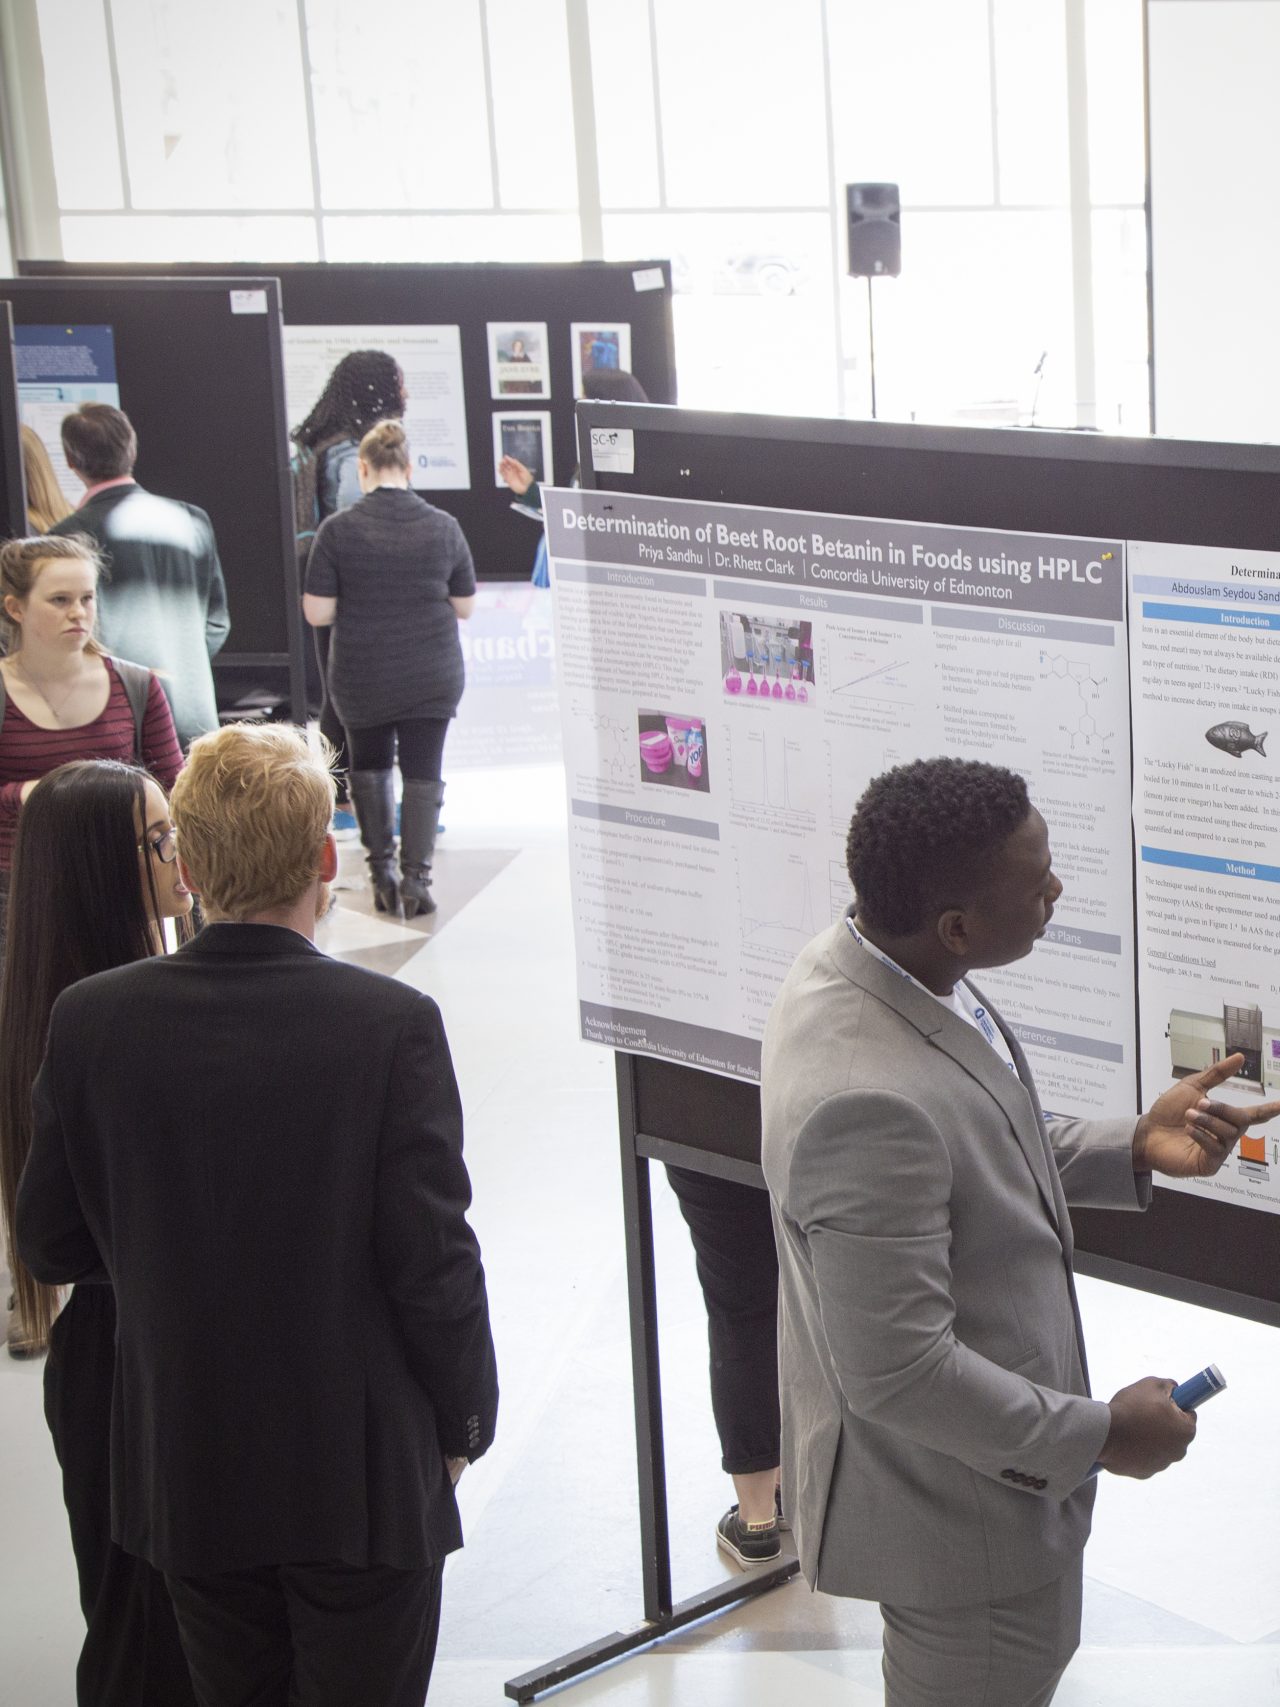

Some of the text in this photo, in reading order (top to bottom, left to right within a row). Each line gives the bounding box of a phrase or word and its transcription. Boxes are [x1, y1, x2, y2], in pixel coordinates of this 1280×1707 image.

[562, 508, 1102, 584] Determination of Beet Root Betanin in Foods using HPLC
[638, 543, 1013, 598] Priya Sandhu Dr. Rhett Clark Concordia University of Edmonton
[607, 572, 655, 585] Introduction
[1171, 582, 1221, 596] Abdouslam
[1222, 587, 1256, 600] Seydou
[799, 594, 828, 608] Results
[998, 617, 1046, 632] Discussion
[1220, 613, 1270, 626] Introduction
[625, 811, 666, 826] Procedure
[1226, 863, 1256, 876] Method
[1058, 930, 1082, 944] Plans
[585, 1016, 647, 1036] Acknowledgement
[1011, 1028, 1057, 1044] eferences
[604, 1033, 616, 1044] you
[616, 1035, 623, 1044] to
[657, 1043, 687, 1061] University
[688, 1051, 696, 1060] of
[696, 1053, 725, 1069] Edmonton
[727, 1060, 736, 1071] for
[737, 1063, 760, 1078] funding
